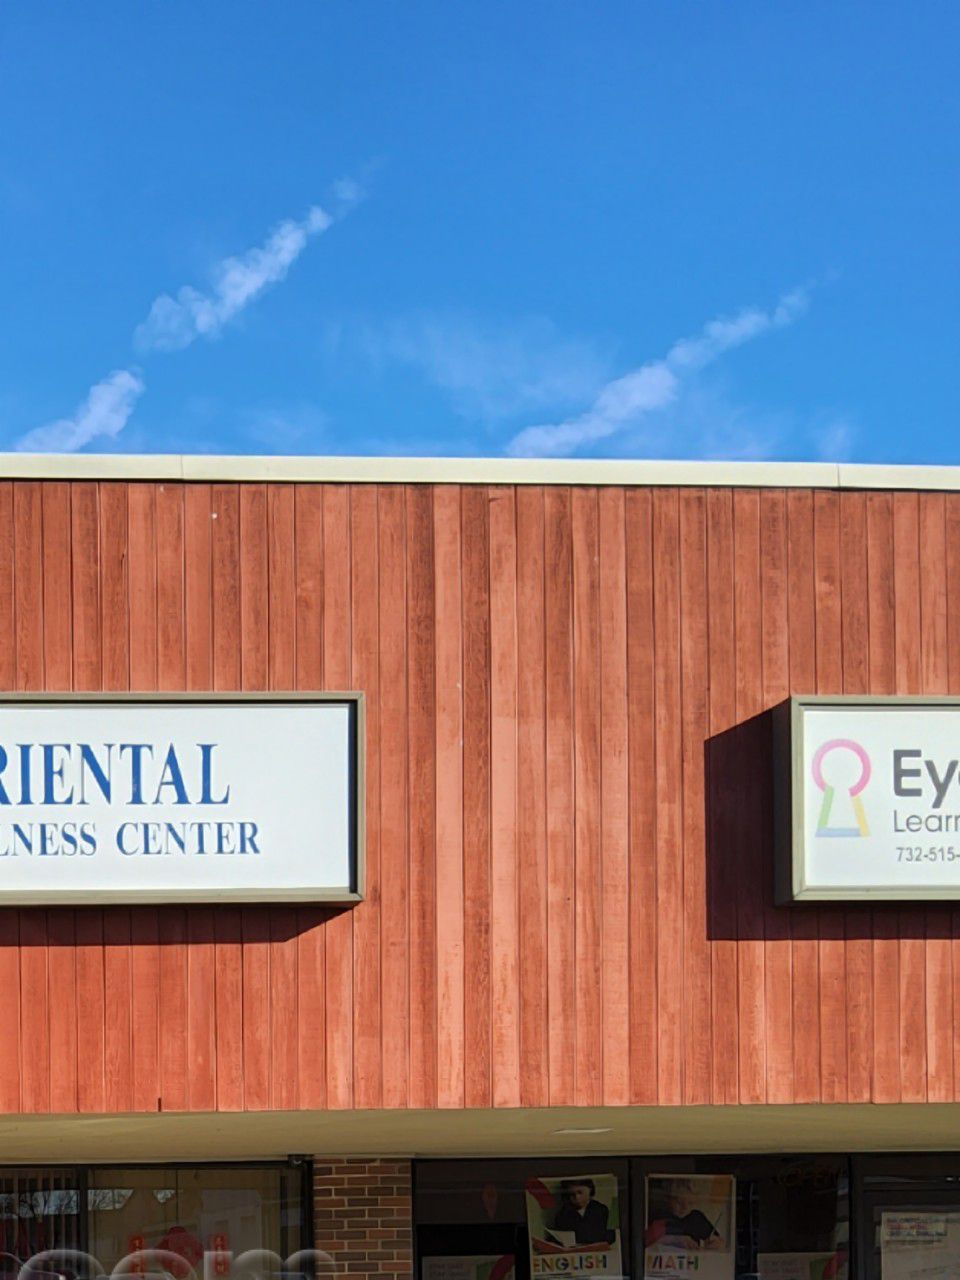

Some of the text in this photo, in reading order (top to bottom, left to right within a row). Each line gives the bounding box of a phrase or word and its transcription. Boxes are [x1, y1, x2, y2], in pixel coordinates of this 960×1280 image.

[893, 749, 960, 809] Ey
[115, 822, 261, 855] CENTER
[533, 1254, 607, 1273] ENGLISH
[647, 1255, 699, 1270] MATH
